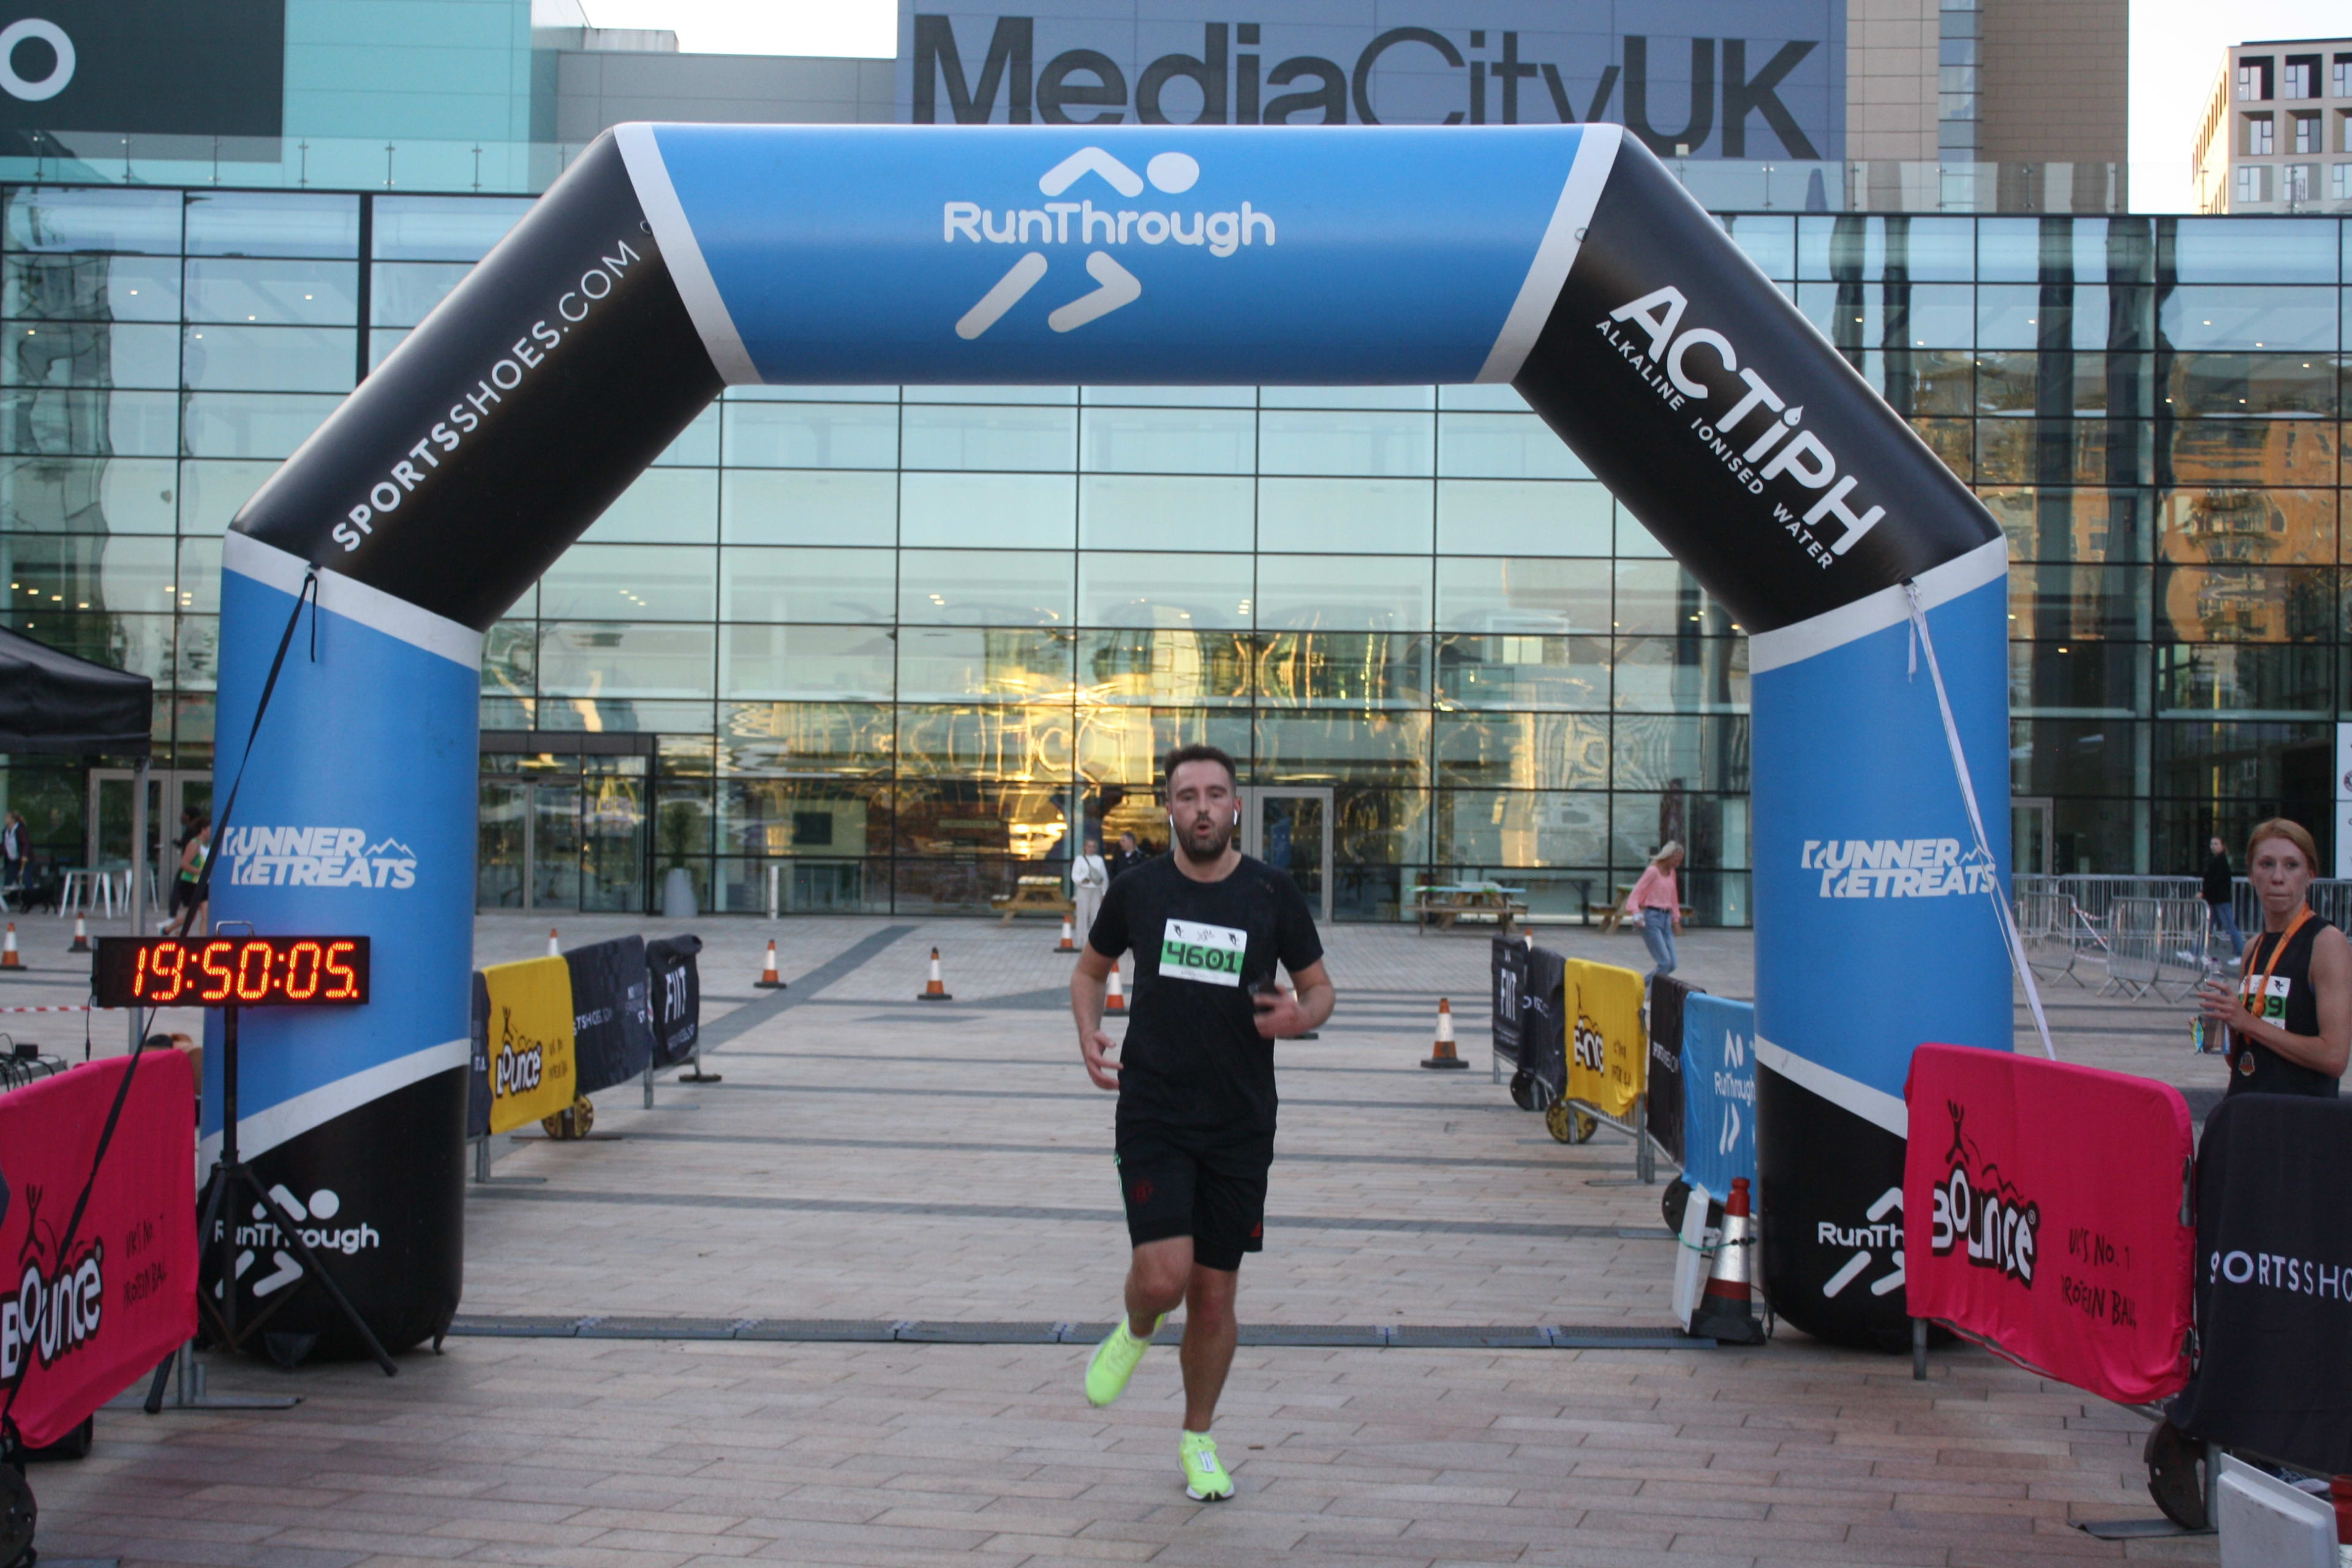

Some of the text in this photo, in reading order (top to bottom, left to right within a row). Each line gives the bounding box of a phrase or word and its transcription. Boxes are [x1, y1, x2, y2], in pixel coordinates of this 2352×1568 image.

[913, 14, 1822, 160] MediaCityUK
[944, 200, 1276, 258] RunThrough
[332, 239, 641, 552] SPORTSSHOES.COM
[1596, 319, 1833, 570] ALKALINE IONISED WATER
[1166, 941, 1237, 973] 4601
